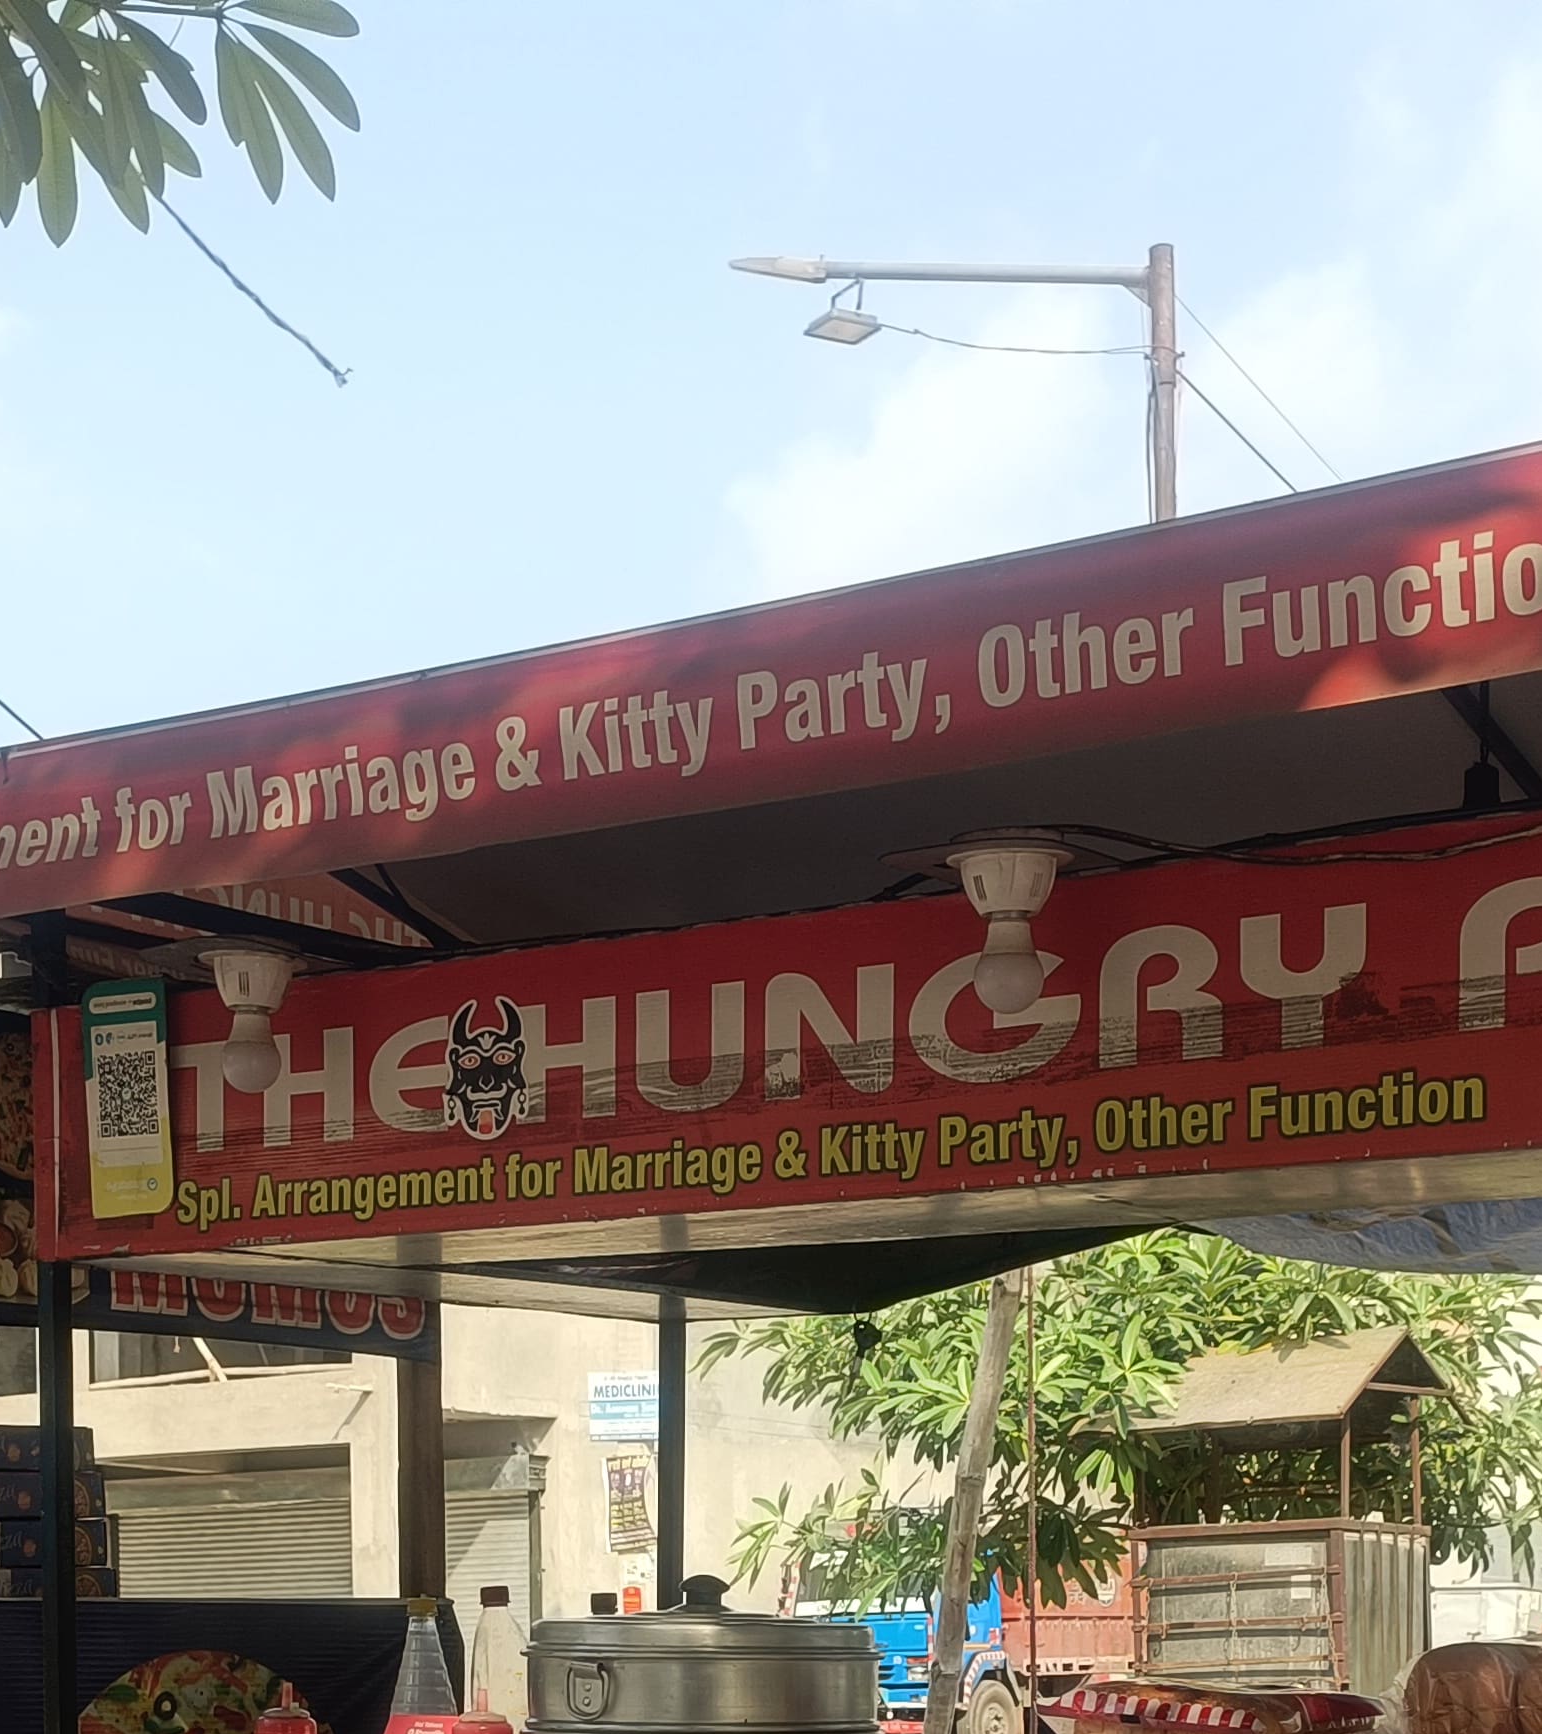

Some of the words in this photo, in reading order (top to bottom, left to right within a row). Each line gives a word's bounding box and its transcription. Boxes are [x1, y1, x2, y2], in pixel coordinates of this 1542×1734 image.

[114, 786, 192, 852] for
[205, 738, 477, 841] Marriage
[495, 717, 542, 792] &
[559, 688, 713, 783] Kitty
[737, 651, 953, 752] Party,
[978, 605, 1194, 710] Other
[175, 1013, 451, 1157] THE
[519, 902, 1368, 1126] HUNGRY
[176, 1174, 242, 1233] Spl.
[252, 1159, 496, 1222] Arrangement
[505, 1154, 561, 1198] for
[573, 1137, 762, 1203] Marriage
[775, 1131, 807, 1179] &
[820, 1122, 924, 1181] Kitty
[940, 1108, 1079, 1168] Party,
[1095, 1094, 1230, 1152] Other
[1249, 1071, 1485, 1140] Function
[594, 1384, 659, 1399] MEDICLINI
